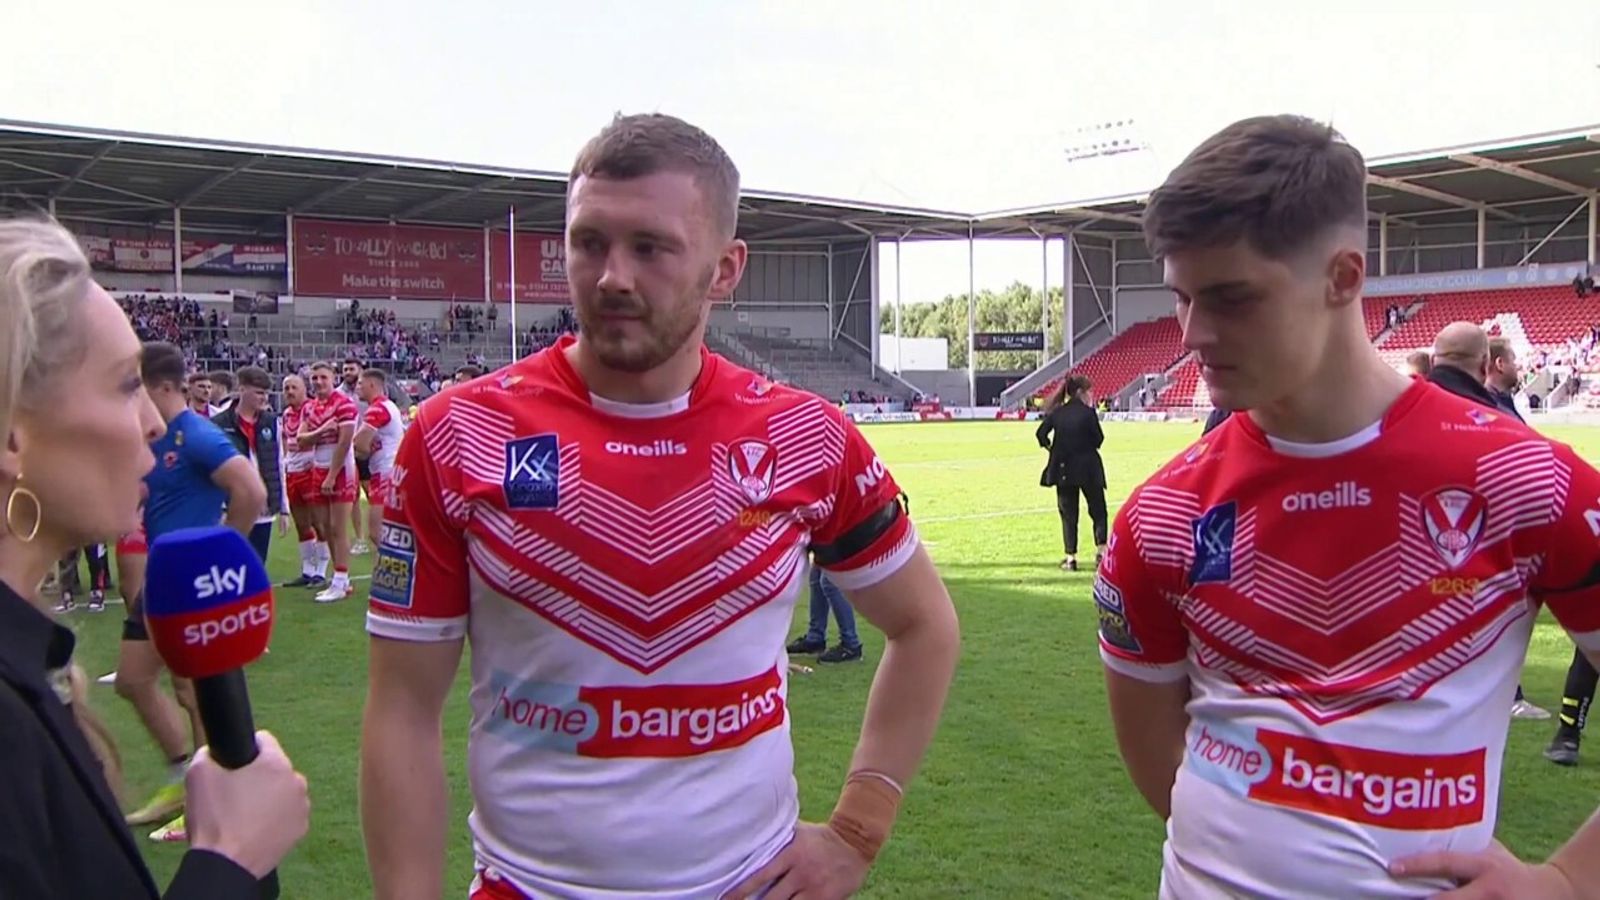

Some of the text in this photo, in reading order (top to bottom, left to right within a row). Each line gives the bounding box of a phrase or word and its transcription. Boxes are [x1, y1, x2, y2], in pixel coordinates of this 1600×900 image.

[342, 273, 378, 289] Make
[402, 276, 446, 290] switch
[193, 564, 247, 599] sky
[184, 602, 270, 646] sports
[492, 686, 779, 745] home bargains
[1193, 726, 1477, 815] home bargains
